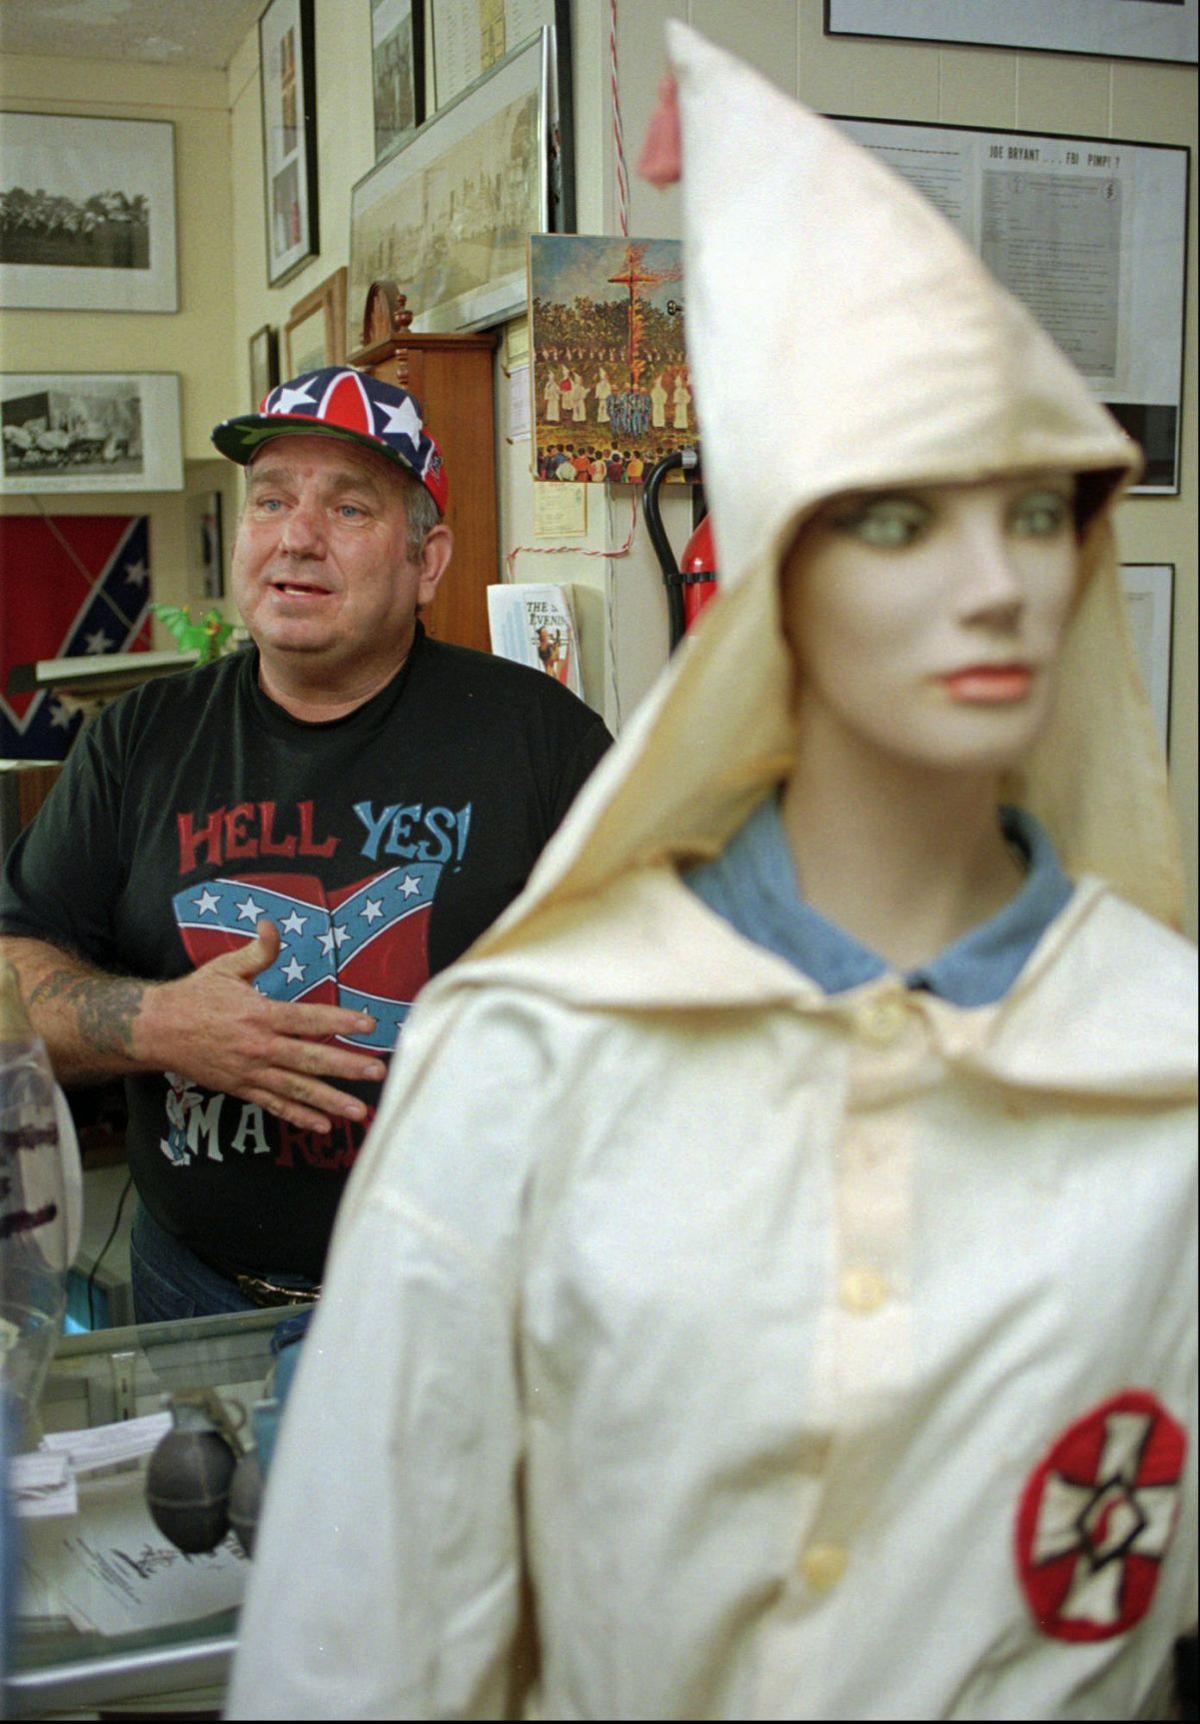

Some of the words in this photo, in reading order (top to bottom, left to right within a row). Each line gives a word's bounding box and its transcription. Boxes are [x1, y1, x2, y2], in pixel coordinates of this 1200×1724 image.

[990, 146, 1003, 159] JOE
[1008, 146, 1040, 161] BRYANT
[1066, 151, 1080, 165] FBI
[526, 601, 549, 613] THE
[177, 801, 340, 874] HELL
[353, 801, 471, 874] YES!
